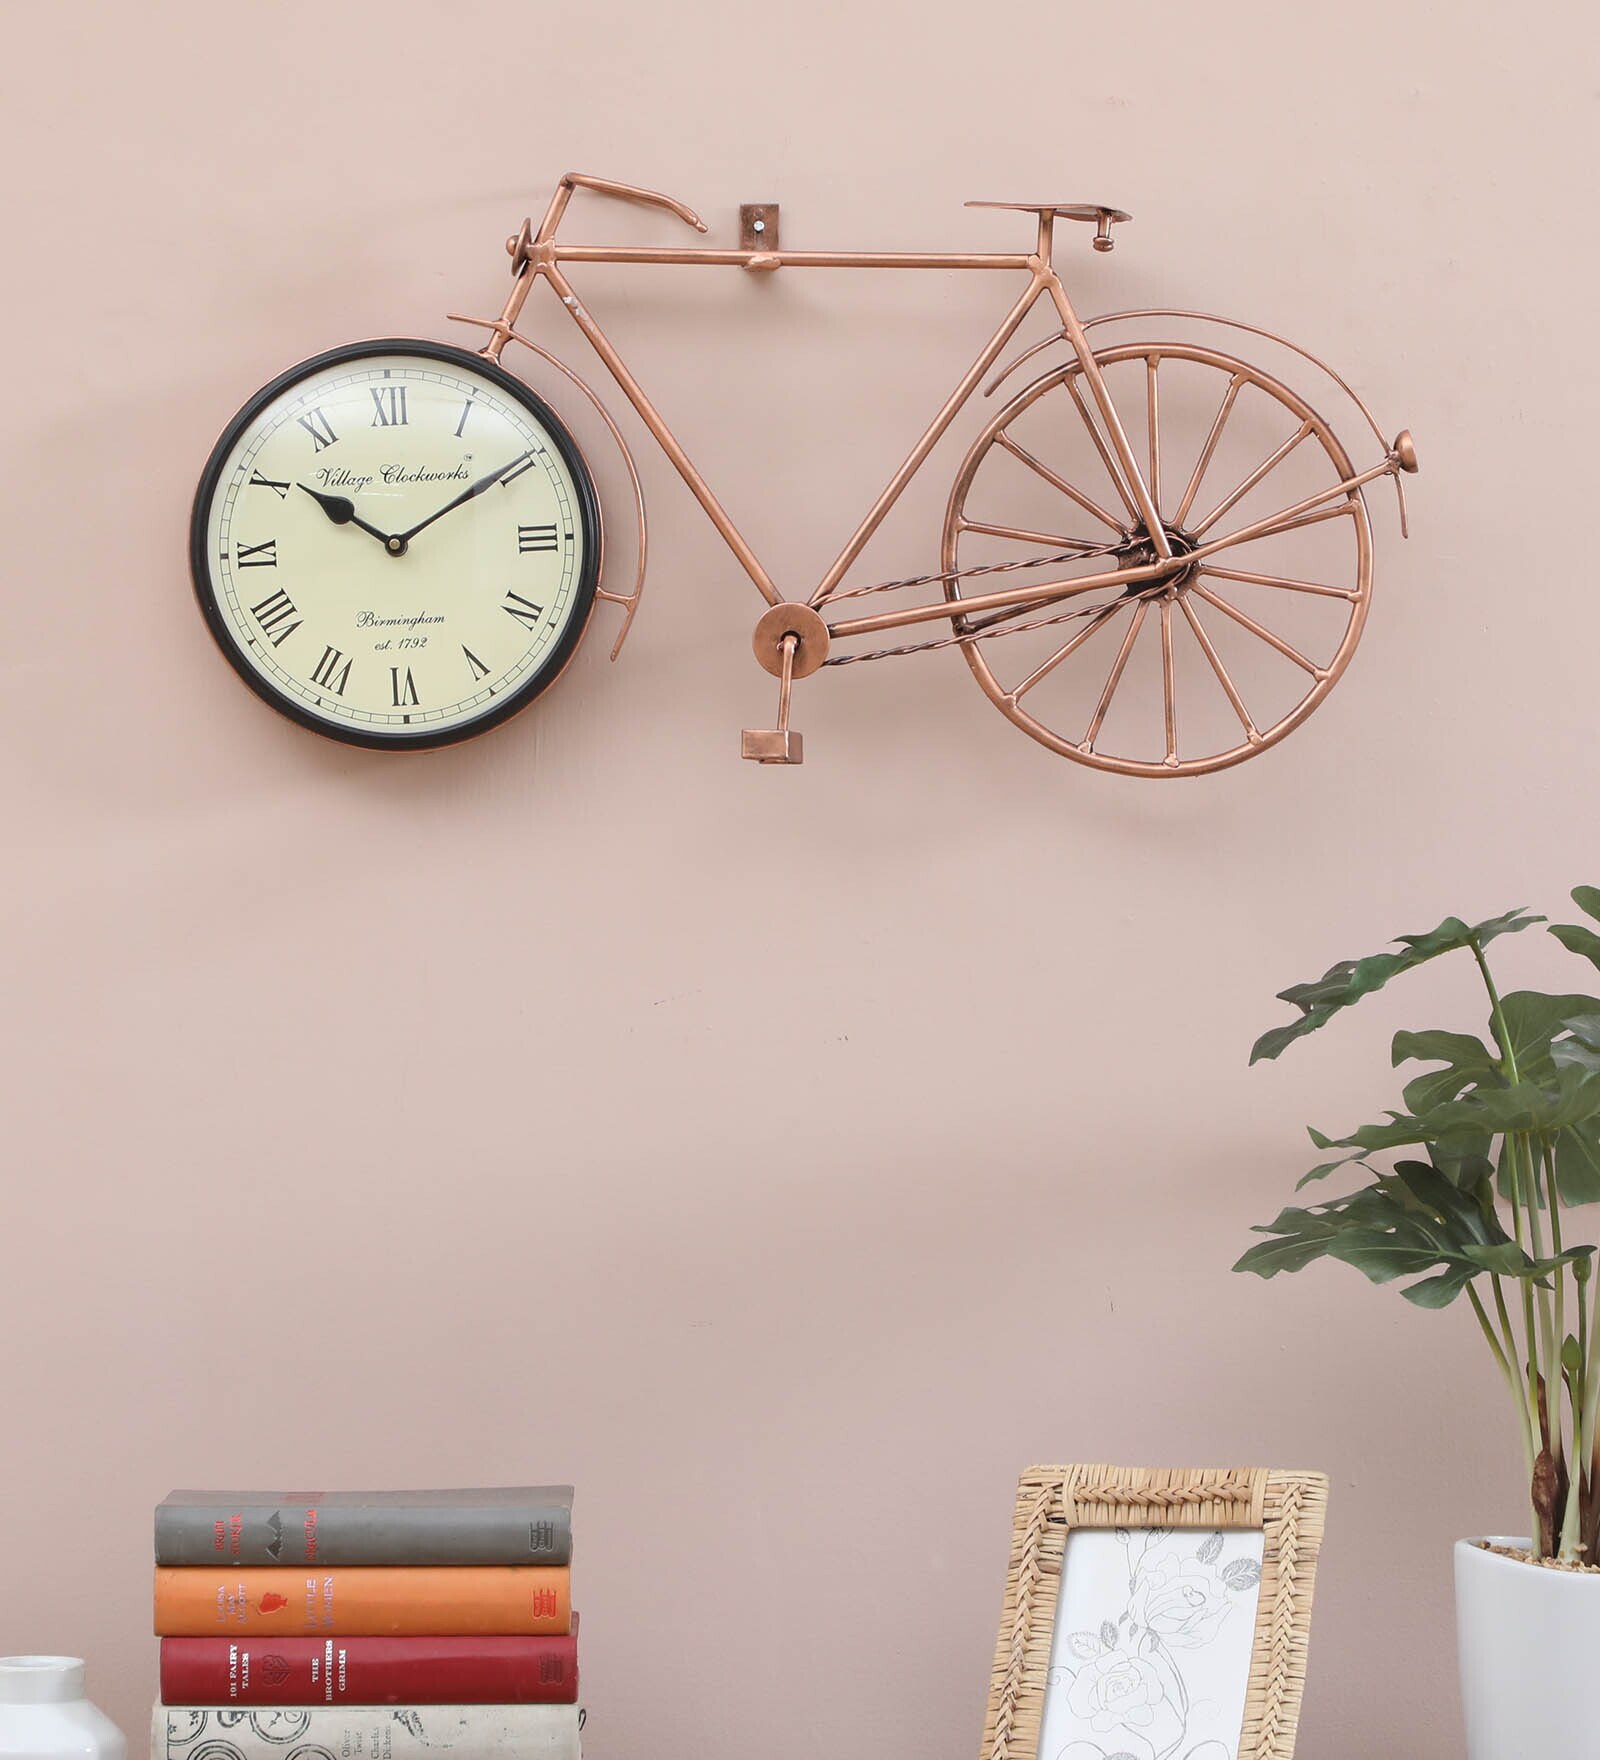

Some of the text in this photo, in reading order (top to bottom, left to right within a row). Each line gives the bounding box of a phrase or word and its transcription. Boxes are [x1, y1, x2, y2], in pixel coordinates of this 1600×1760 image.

[370, 386, 408, 427] XII
[453, 399, 474, 438] I
[297, 407, 340, 453] XI
[250, 468, 292, 499] X
[316, 463, 469, 493] Village Clockworks
[237, 539, 277, 569] IX
[518, 523, 558, 554] III
[250, 588, 304, 648] VIII
[356, 610, 447, 631] Birmingham
[500, 590, 544, 631] IV
[374, 637, 428, 651] est. 1792
[462, 643, 491, 681] V
[310, 645, 354, 696] VII
[390, 666, 420, 707] VI
[229, 1644, 238, 1697] 101 FAIRY
[242, 1652, 250, 1689] TALES
[311, 1657, 320, 1683] THE
[325, 1639, 334, 1701] BROTHERS
[338, 1649, 347, 1692] GRIMM
